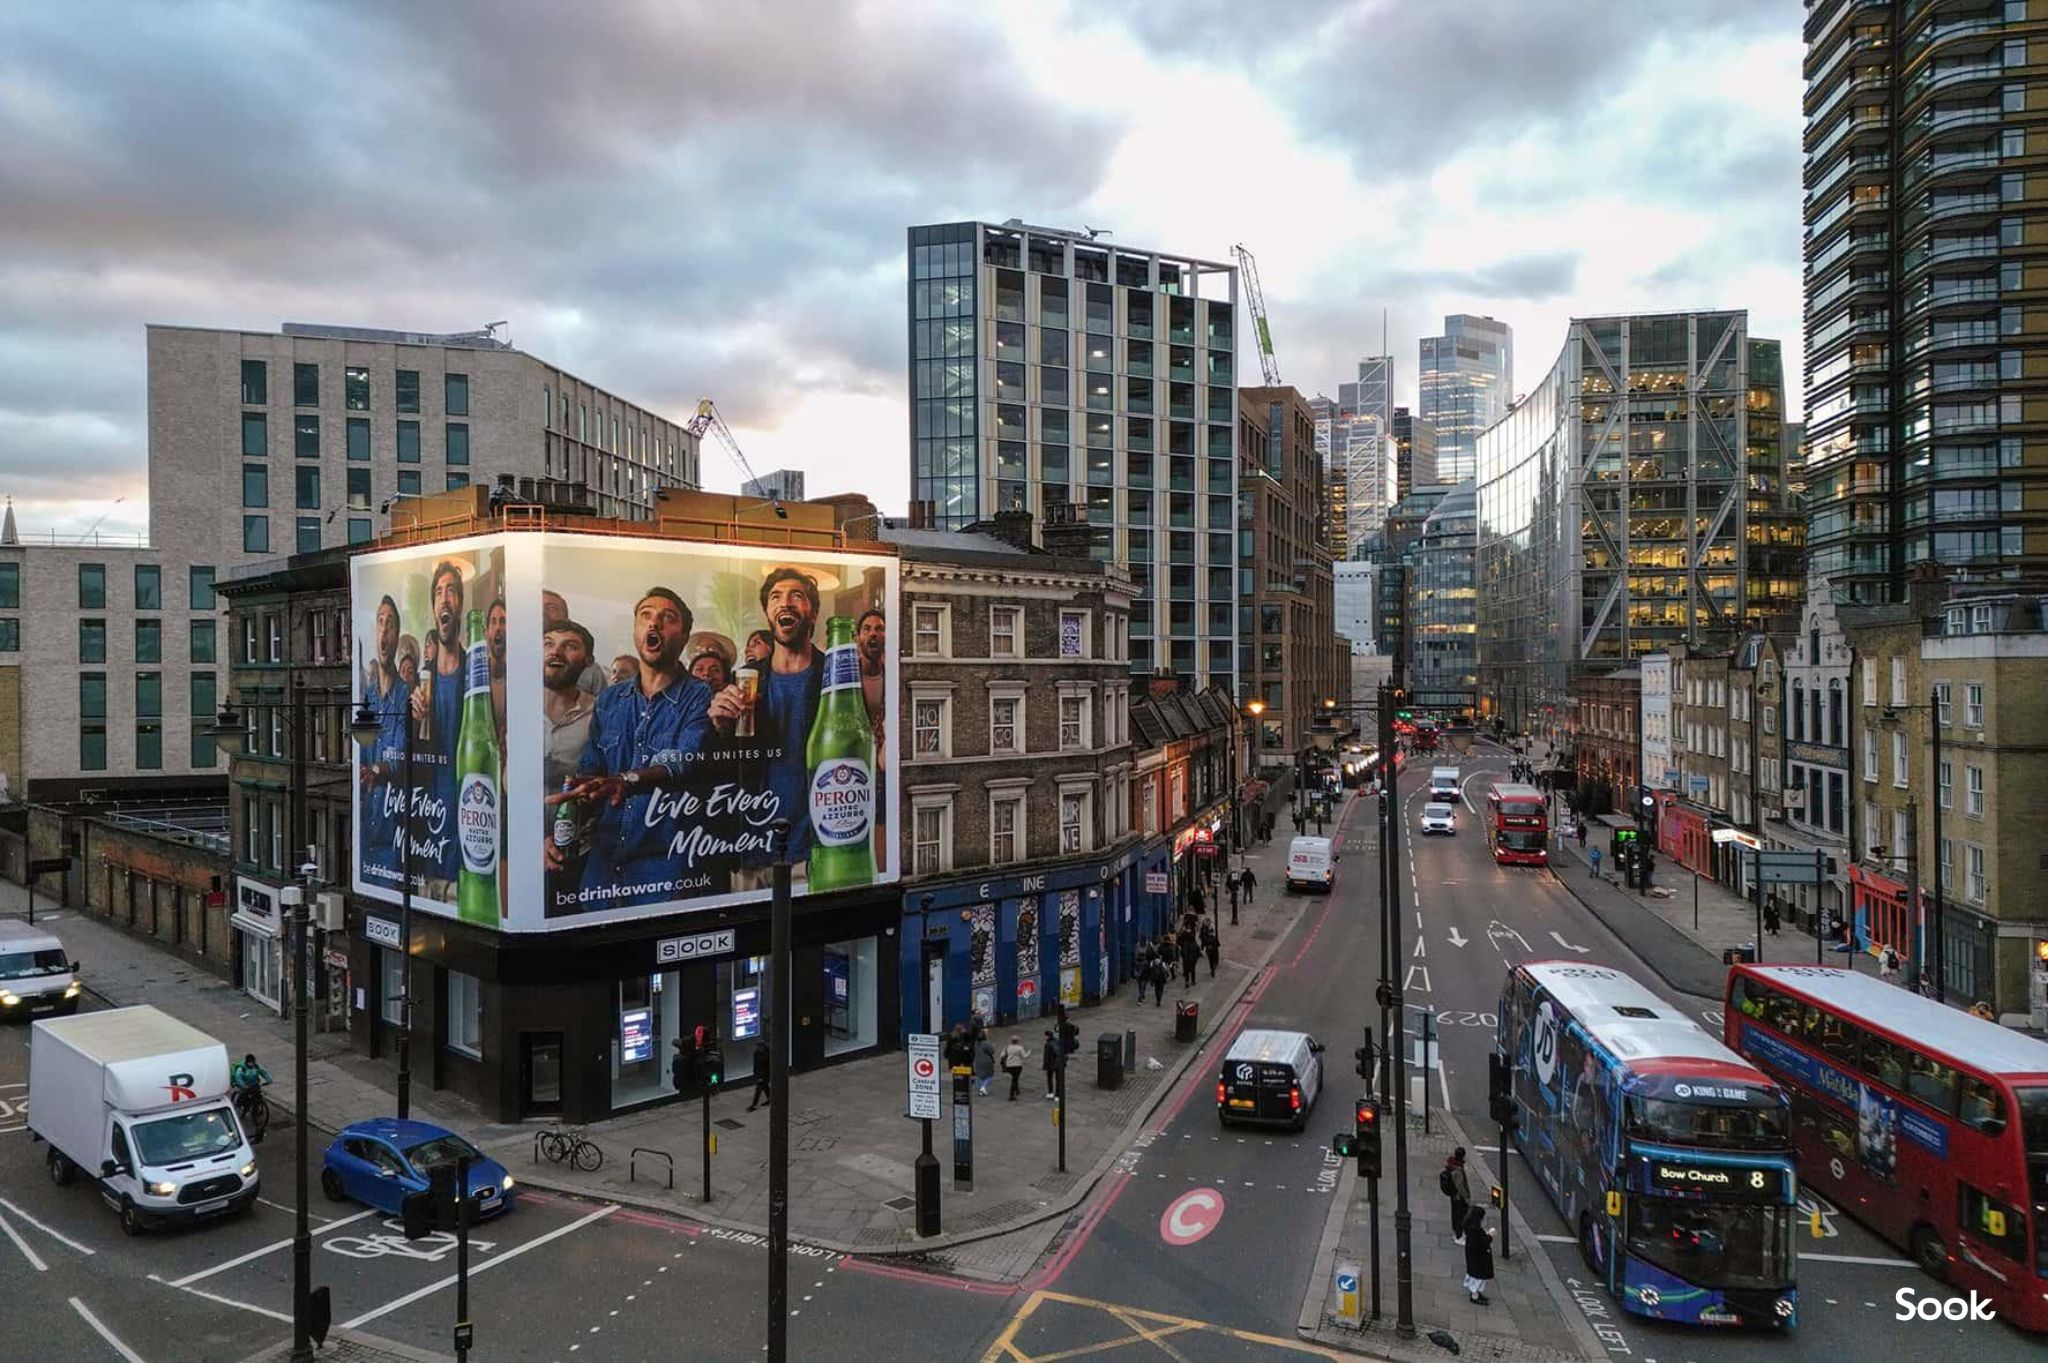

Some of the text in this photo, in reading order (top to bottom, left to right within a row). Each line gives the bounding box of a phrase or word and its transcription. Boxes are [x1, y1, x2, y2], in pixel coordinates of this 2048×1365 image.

[382, 746, 448, 765] PASSIO UNITES US
[641, 748, 783, 764] PASSION UNITES US
[383, 781, 447, 834] Live Every
[644, 782, 780, 828] Live Every
[815, 789, 870, 807] PERONI
[828, 804, 859, 812] NASTRO
[822, 810, 865, 820] AZZURRO
[393, 825, 450, 865] Mment
[368, 924, 398, 941] SOOK
[663, 935, 730, 957] SOOK
[164, 1073, 197, 1102] R
[1692, 1085, 1714, 1097] KING
[1723, 1088, 1748, 1101] GAME
[1660, 1167, 1765, 1188] Bow Church 8
[1169, 1194, 1216, 1237] C
[716, 1230, 837, 1261] LOOK IGHT
[1571, 1289, 1632, 1355] LOOK LEFT
